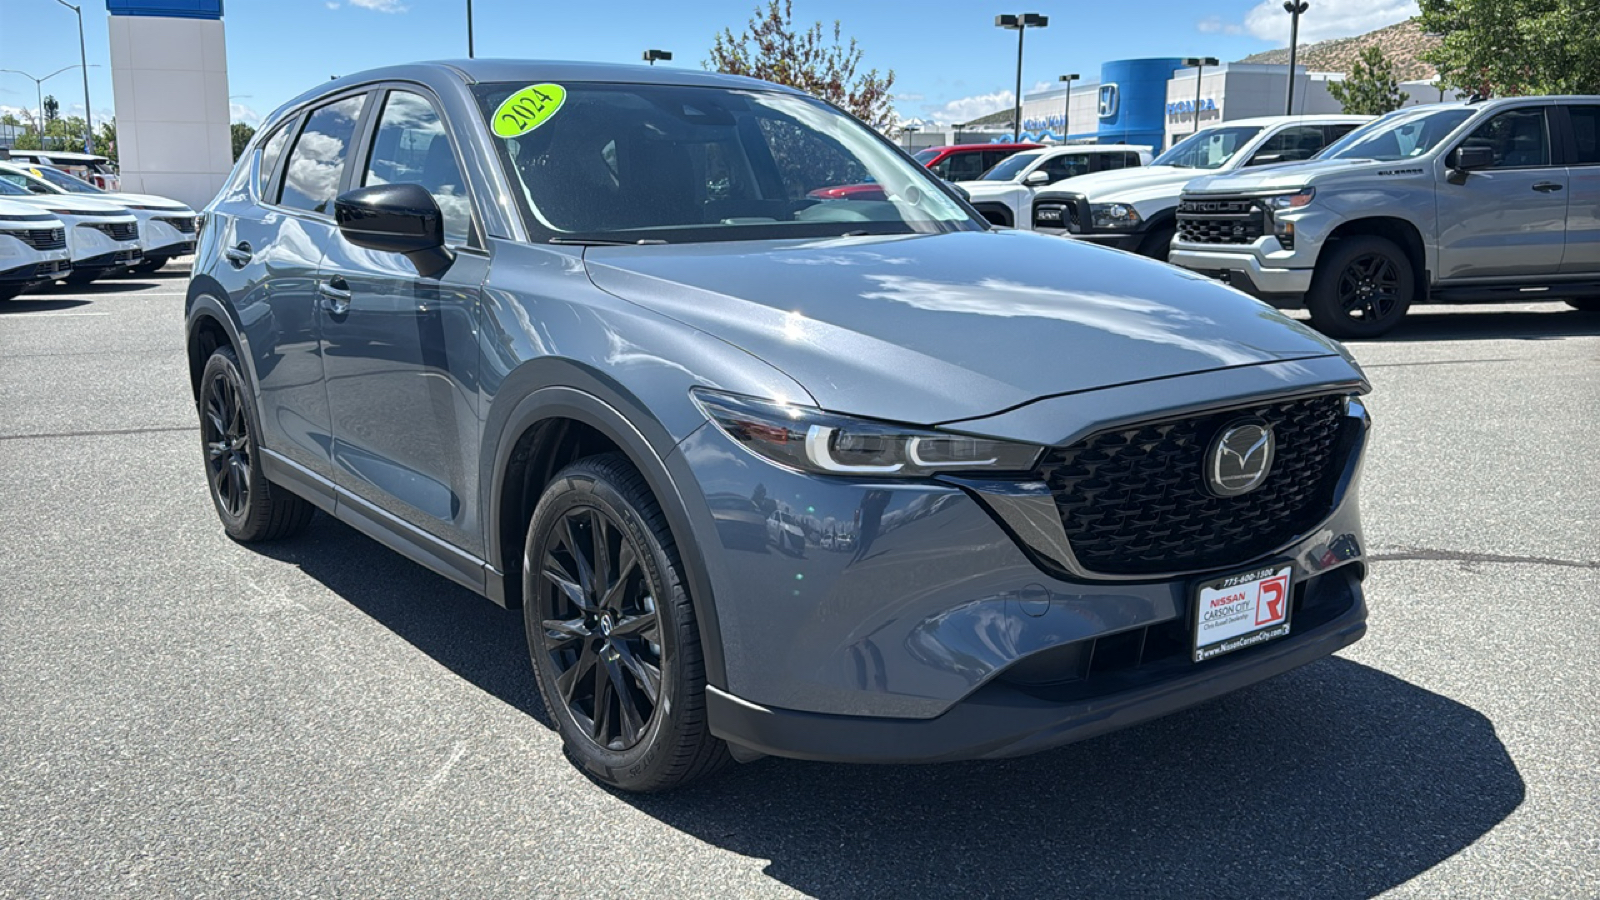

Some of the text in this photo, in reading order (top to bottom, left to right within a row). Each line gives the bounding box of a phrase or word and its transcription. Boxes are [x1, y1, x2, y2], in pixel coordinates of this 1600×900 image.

[501, 88, 554, 131] 2024
[1165, 98, 1216, 115] HONDA
[1038, 210, 1060, 220] RAM
[1210, 591, 1246, 608] NISSAN
[1203, 600, 1251, 621] CARSON CITY
[1203, 622, 1215, 631] Chris
[1204, 628, 1282, 657] www.NissanCarsonCity.com
